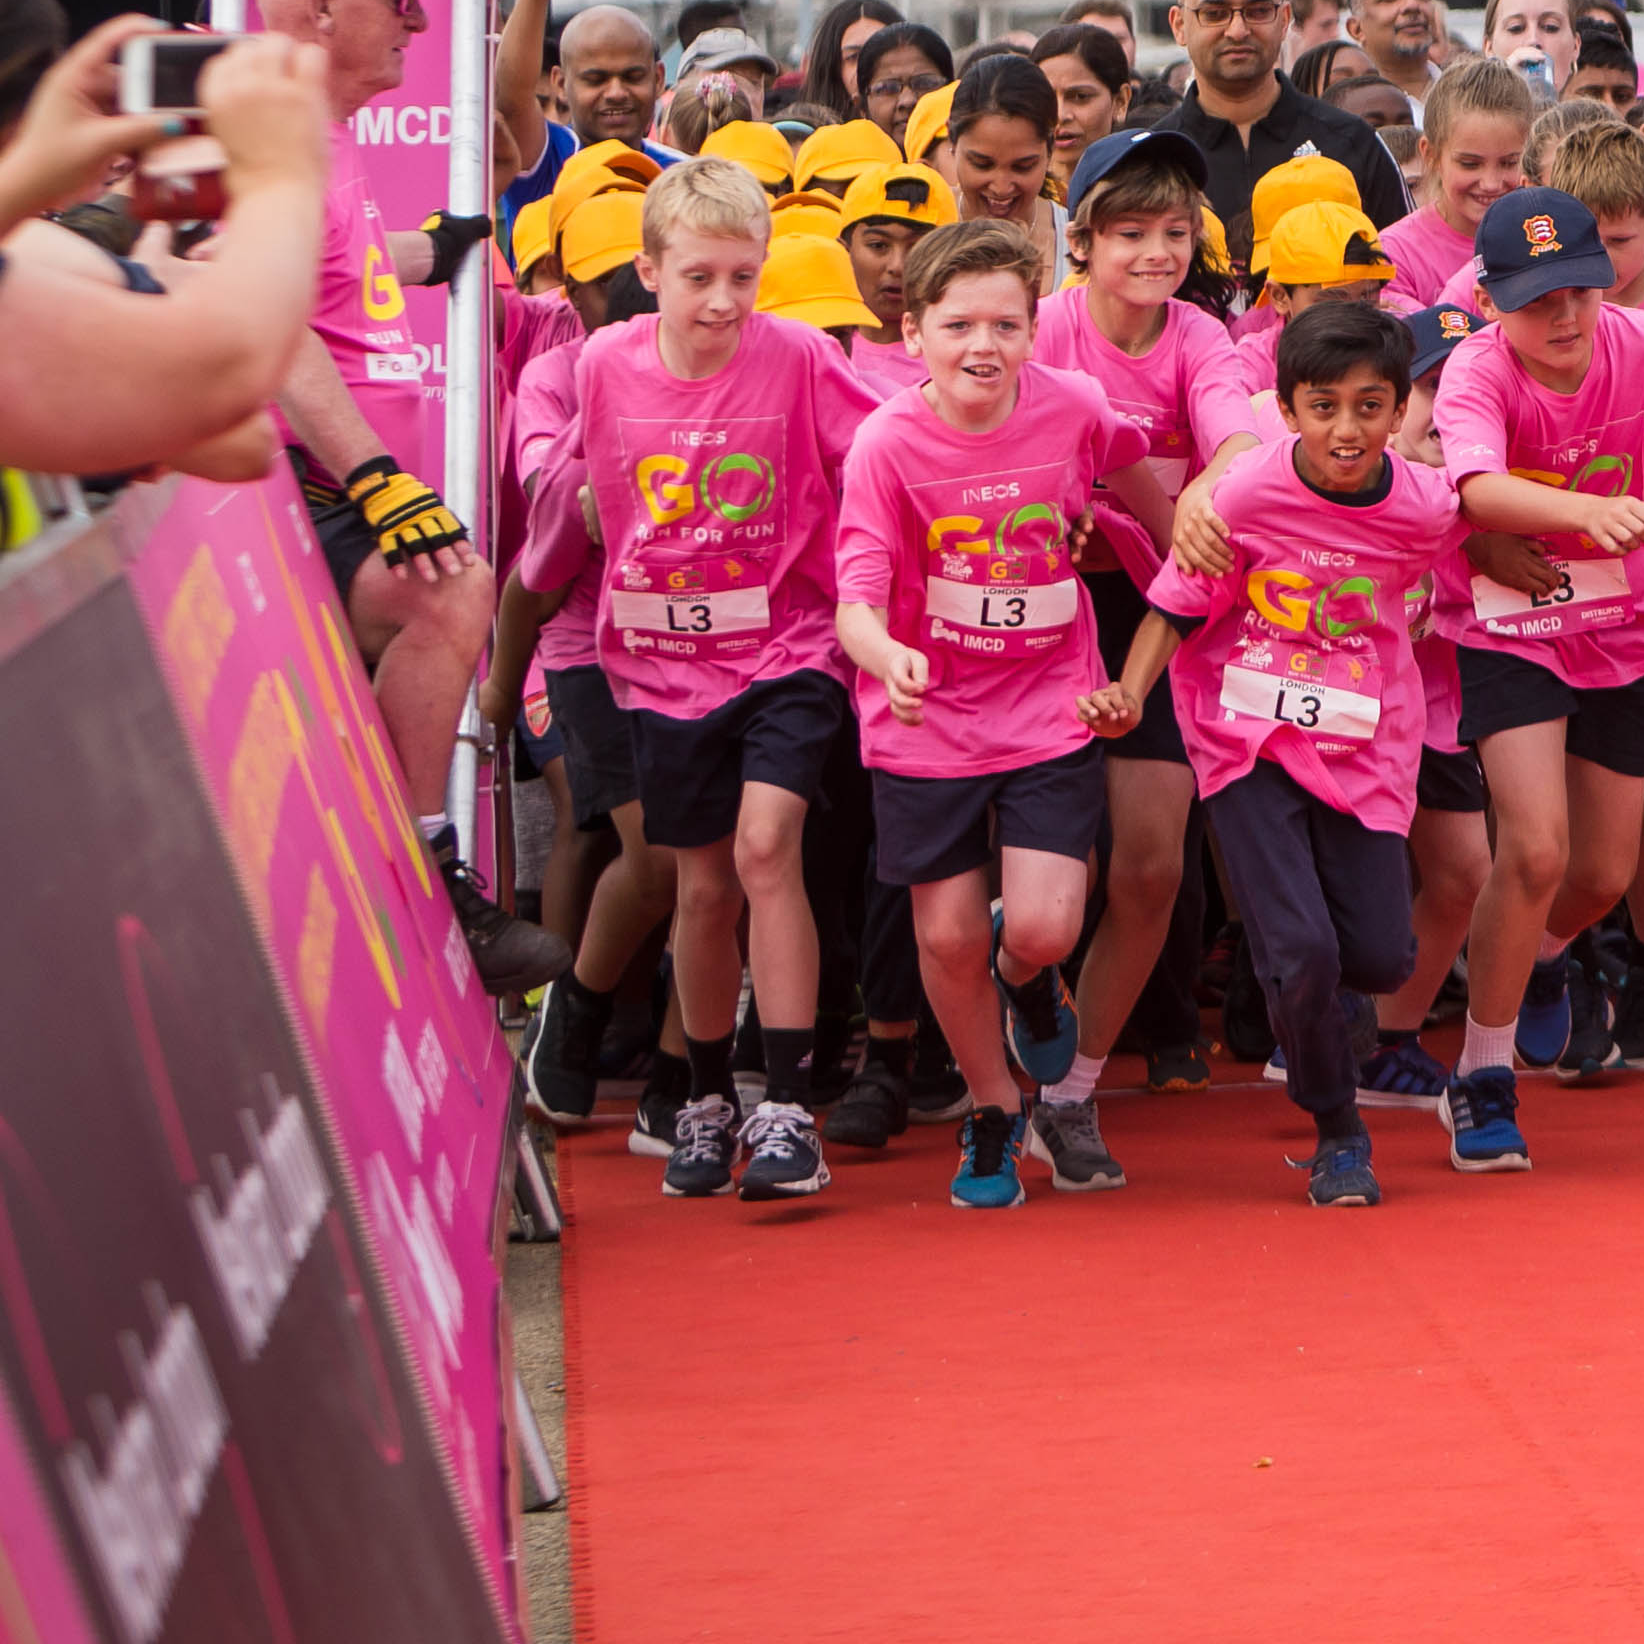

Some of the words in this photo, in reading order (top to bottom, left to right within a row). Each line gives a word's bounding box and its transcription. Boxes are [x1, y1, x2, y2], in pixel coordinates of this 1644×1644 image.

[671, 430, 728, 447] INEOS
[635, 452, 778, 526] GO
[962, 481, 1021, 506] INEOS
[680, 526, 724, 544] FOR
[733, 523, 776, 542] FUN
[1301, 548, 1356, 568] INEOS
[665, 595, 711, 603] LONDON
[982, 587, 1030, 596] LONDON
[1530, 570, 1575, 608] L3
[980, 596, 1027, 628] L3
[1246, 568, 1380, 638] GO
[666, 603, 713, 633] L3
[1520, 615, 1563, 637] IMCD
[657, 637, 698, 655] IMCD
[963, 633, 1006, 653] IMCD
[1279, 678, 1326, 696] LONDON
[1274, 689, 1322, 728] L3
